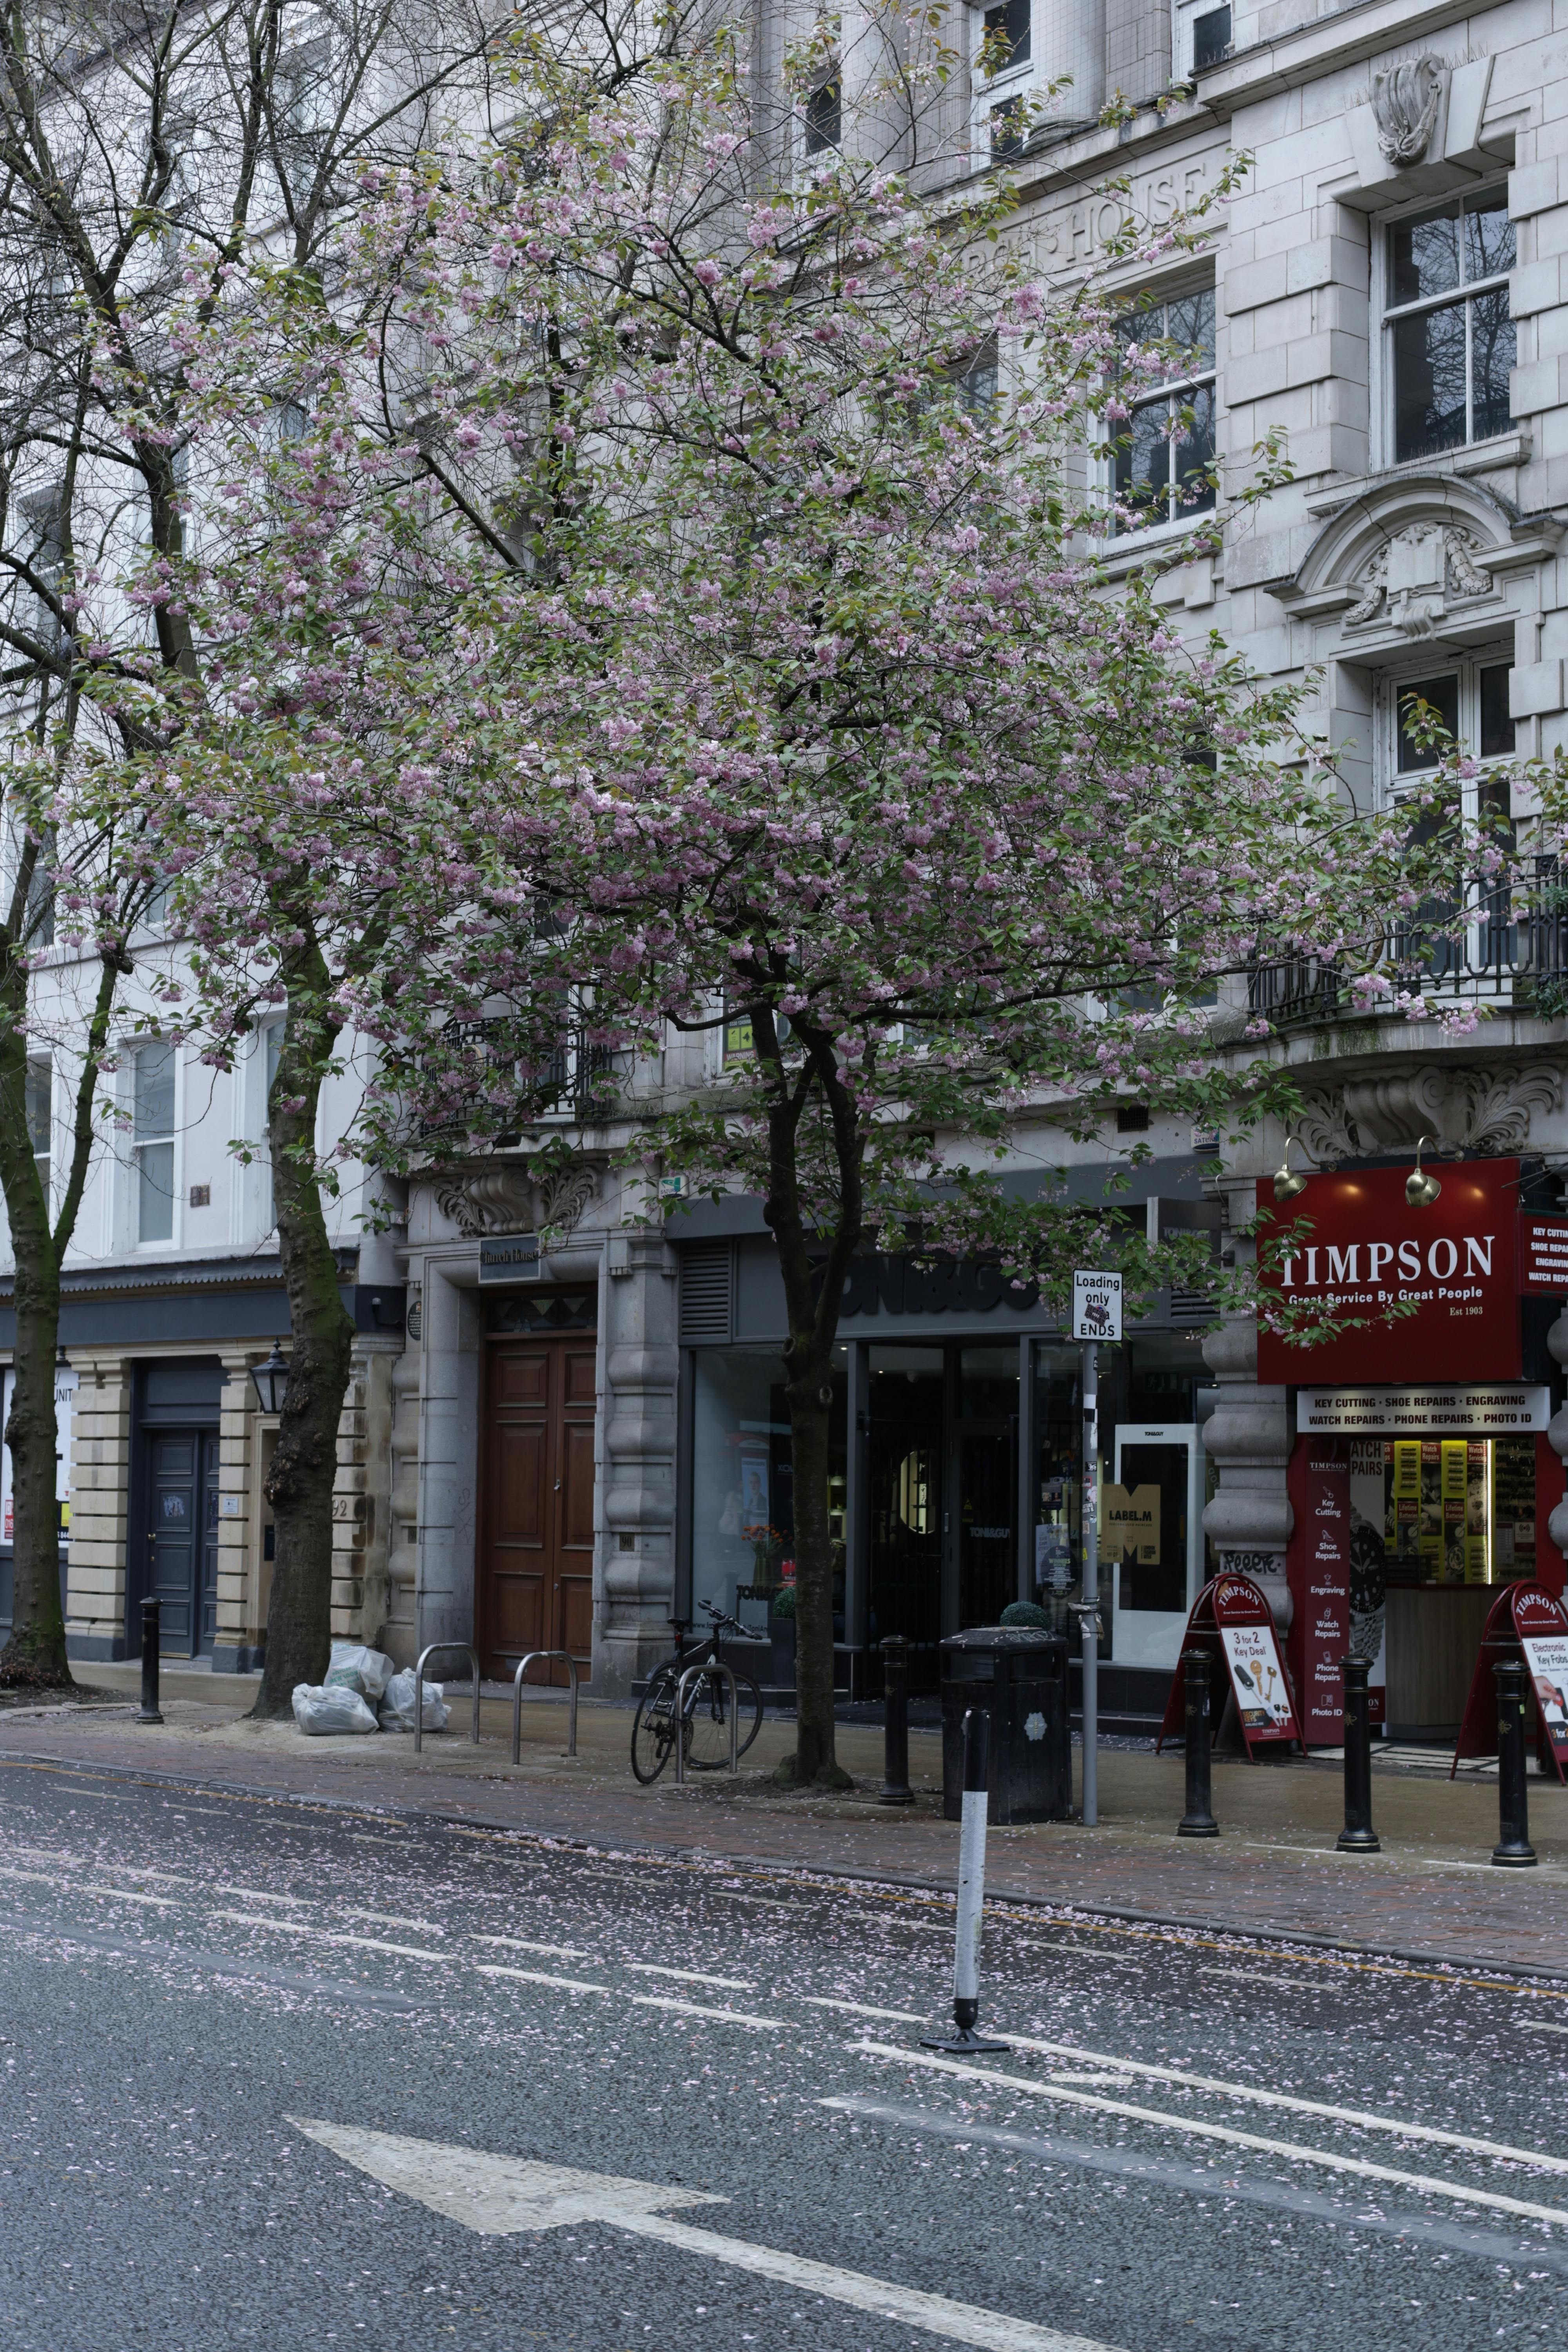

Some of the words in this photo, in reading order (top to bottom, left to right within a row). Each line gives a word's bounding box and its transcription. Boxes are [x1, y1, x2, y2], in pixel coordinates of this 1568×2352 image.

[1065, 162, 1207, 263] HOUSE
[727, 1051, 754, 1061] WARNING
[1533, 1227, 1546, 1236] KEY
[1531, 1242, 1548, 1251] SHOE
[479, 1249, 508, 1263] Church
[510, 1249, 536, 1261] House
[1275, 1236, 1495, 1287] TIMPSON
[1529, 1272, 1551, 1281] WATCH
[1076, 1274, 1120, 1291] Loading
[1086, 1292, 1109, 1306] only
[1289, 1294, 1322, 1305] Great
[1327, 1292, 1373, 1304] Service
[1378, 1290, 1394, 1304] By
[1398, 1289, 1433, 1301] Great
[1439, 1286, 1483, 1299] People
[1450, 1307, 1463, 1316] Est
[1465, 1306, 1483, 1315] 1903
[1080, 1323, 1114, 1337] ENDS
[1314, 1399, 1333, 1408] KEY
[1336, 1398, 1376, 1408] CUTTING
[1385, 1397, 1411, 1407] SHOE
[1414, 1397, 1456, 1406] REPAIRS
[1466, 1396, 1525, 1406] ENGRAVING
[1309, 1415, 1341, 1425] WATCH
[1345, 1415, 1385, 1425] REPAIRS
[1394, 1415, 1428, 1424] PHONE
[1431, 1414, 1474, 1424] REPAIRS
[1484, 1414, 1517, 1423] PHOTO
[1521, 1414, 1532, 1423] ID
[1422, 1453, 1439, 1461] Repairs
[1350, 1461, 1382, 1475] PAIRS
[332, 1500, 347, 1517] 92
[1322, 1499, 1335, 1508] Key
[1109, 1510, 1152, 1521] LABEL.M
[1315, 1508, 1341, 1518] Cutting
[1315, 1552, 1341, 1561] Repairs
[1310, 1586, 1345, 1595] Engraving
[1218, 1586, 1260, 1607] TIMPSON
[1515, 1593, 1557, 1617] TIMPSON
[1234, 1632, 1240, 1644] 3
[1242, 1635, 1251, 1644] for
[1252, 1632, 1260, 1643] 2
[1315, 1630, 1341, 1639] Repairs
[1234, 1647, 1247, 1658] Key
[1532, 1642, 1566, 1653] Electronic
[1537, 1655, 1550, 1666] Key
[1551, 1654, 1568, 1664] Fobs
[1314, 1673, 1341, 1682] Repairs
